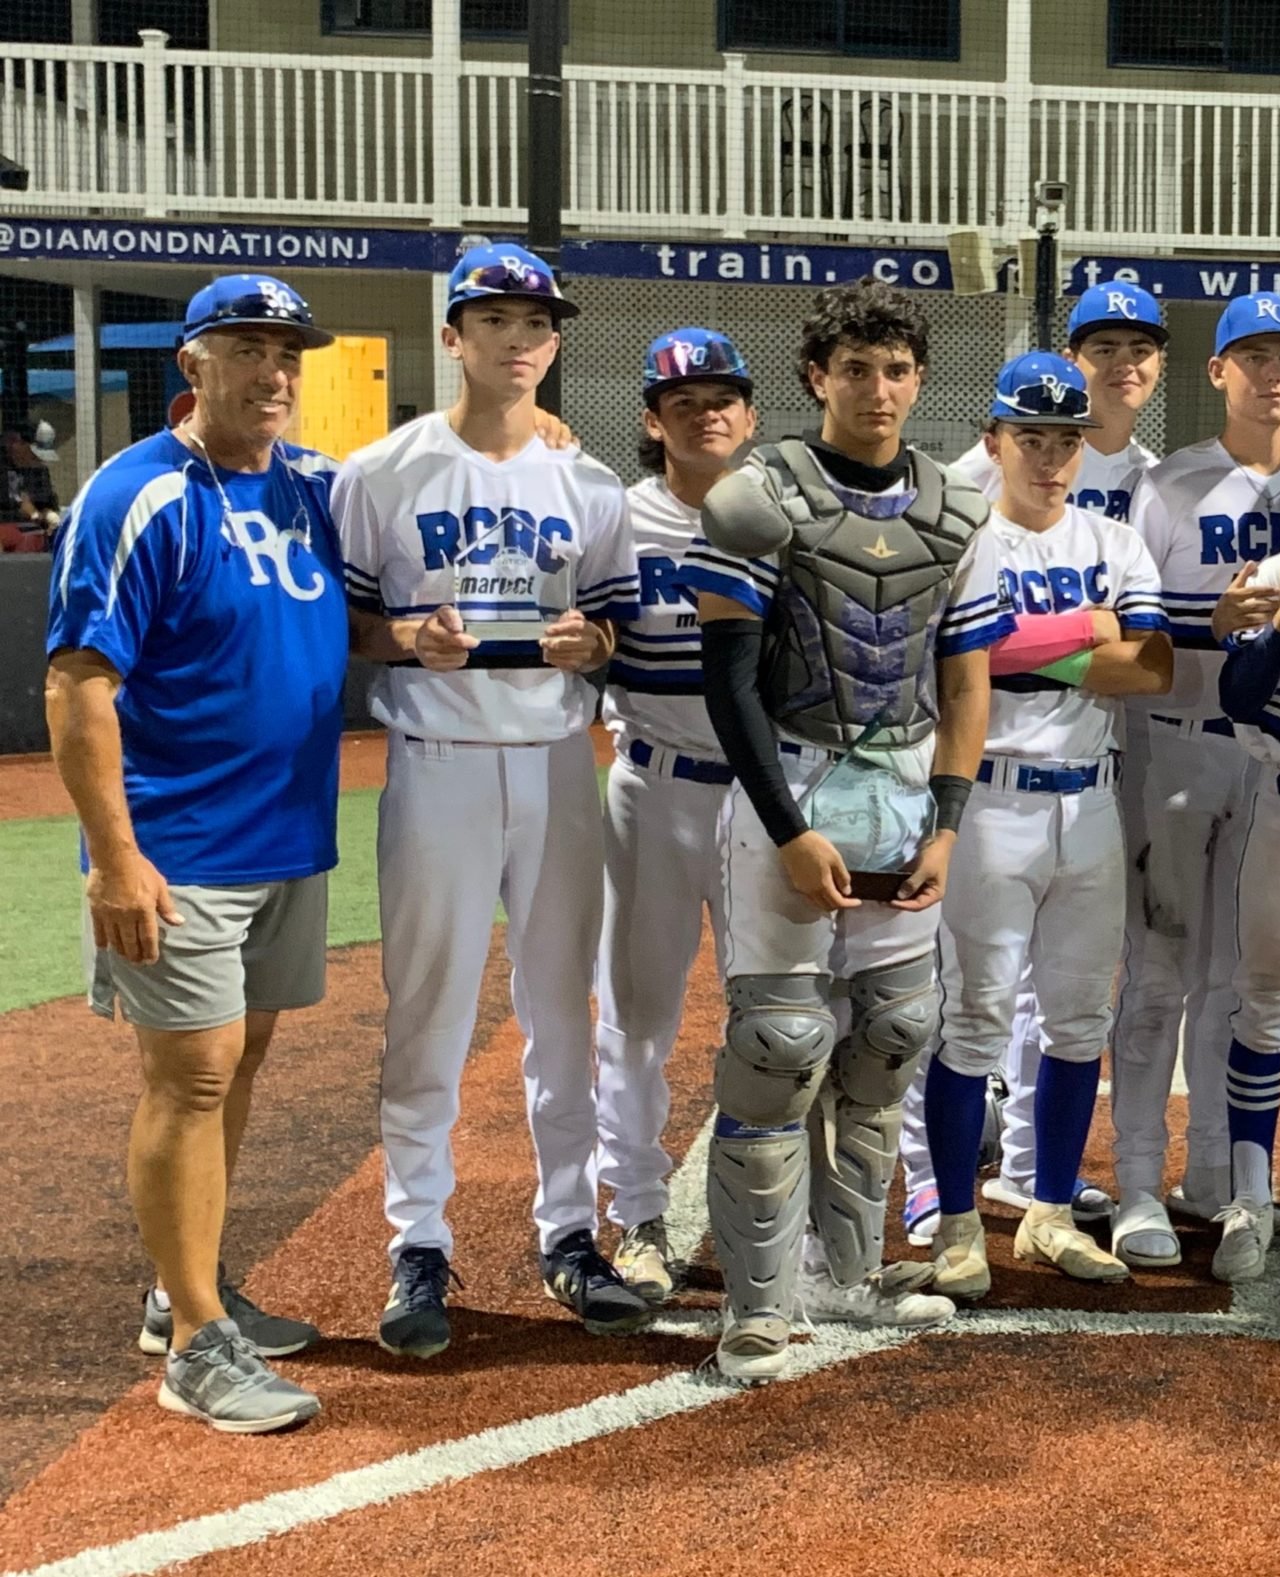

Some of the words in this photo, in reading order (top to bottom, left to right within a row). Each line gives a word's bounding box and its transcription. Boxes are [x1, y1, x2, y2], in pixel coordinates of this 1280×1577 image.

[656, 244, 836, 282] train.
[1107, 291, 1137, 320] RC
[226, 511, 326, 601] RC
[416, 506, 573, 575] RCBC
